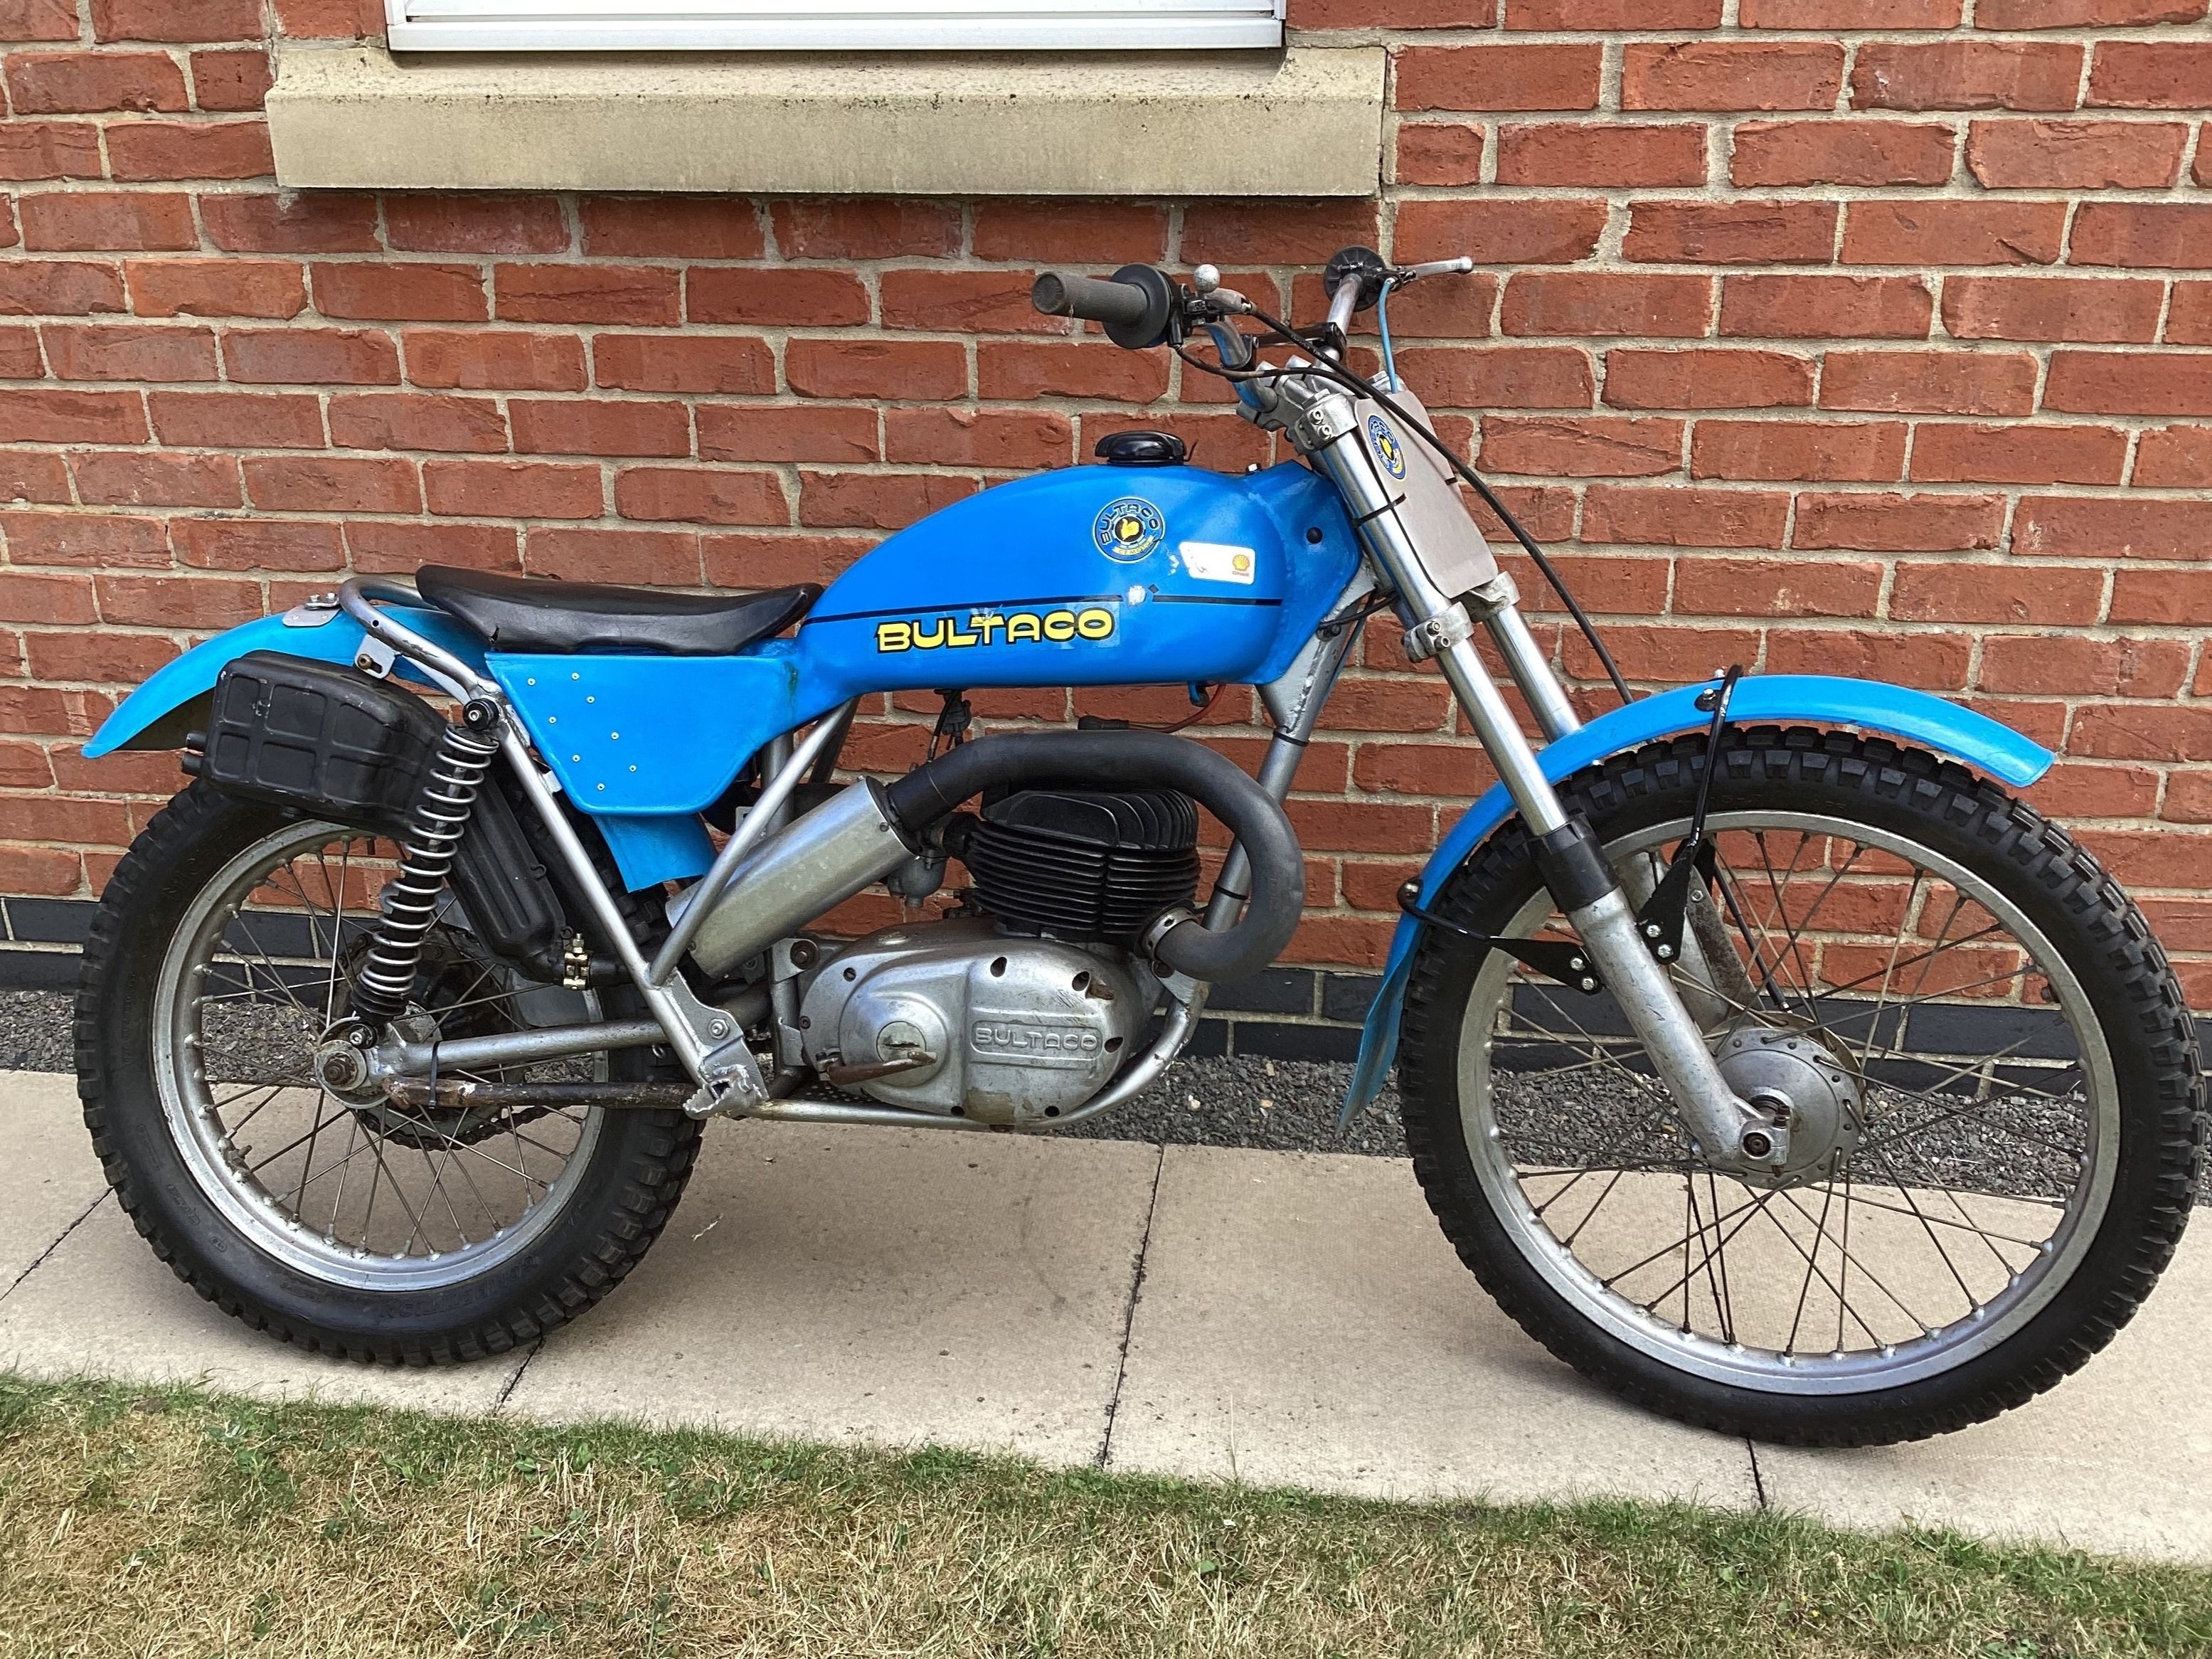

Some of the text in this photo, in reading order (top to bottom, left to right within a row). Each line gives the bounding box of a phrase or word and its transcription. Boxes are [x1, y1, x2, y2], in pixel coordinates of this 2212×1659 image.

[1100, 503, 1159, 545] BULTACO
[876, 607, 1115, 654] BULTACO
[975, 1027, 1098, 1051] BULTACO
